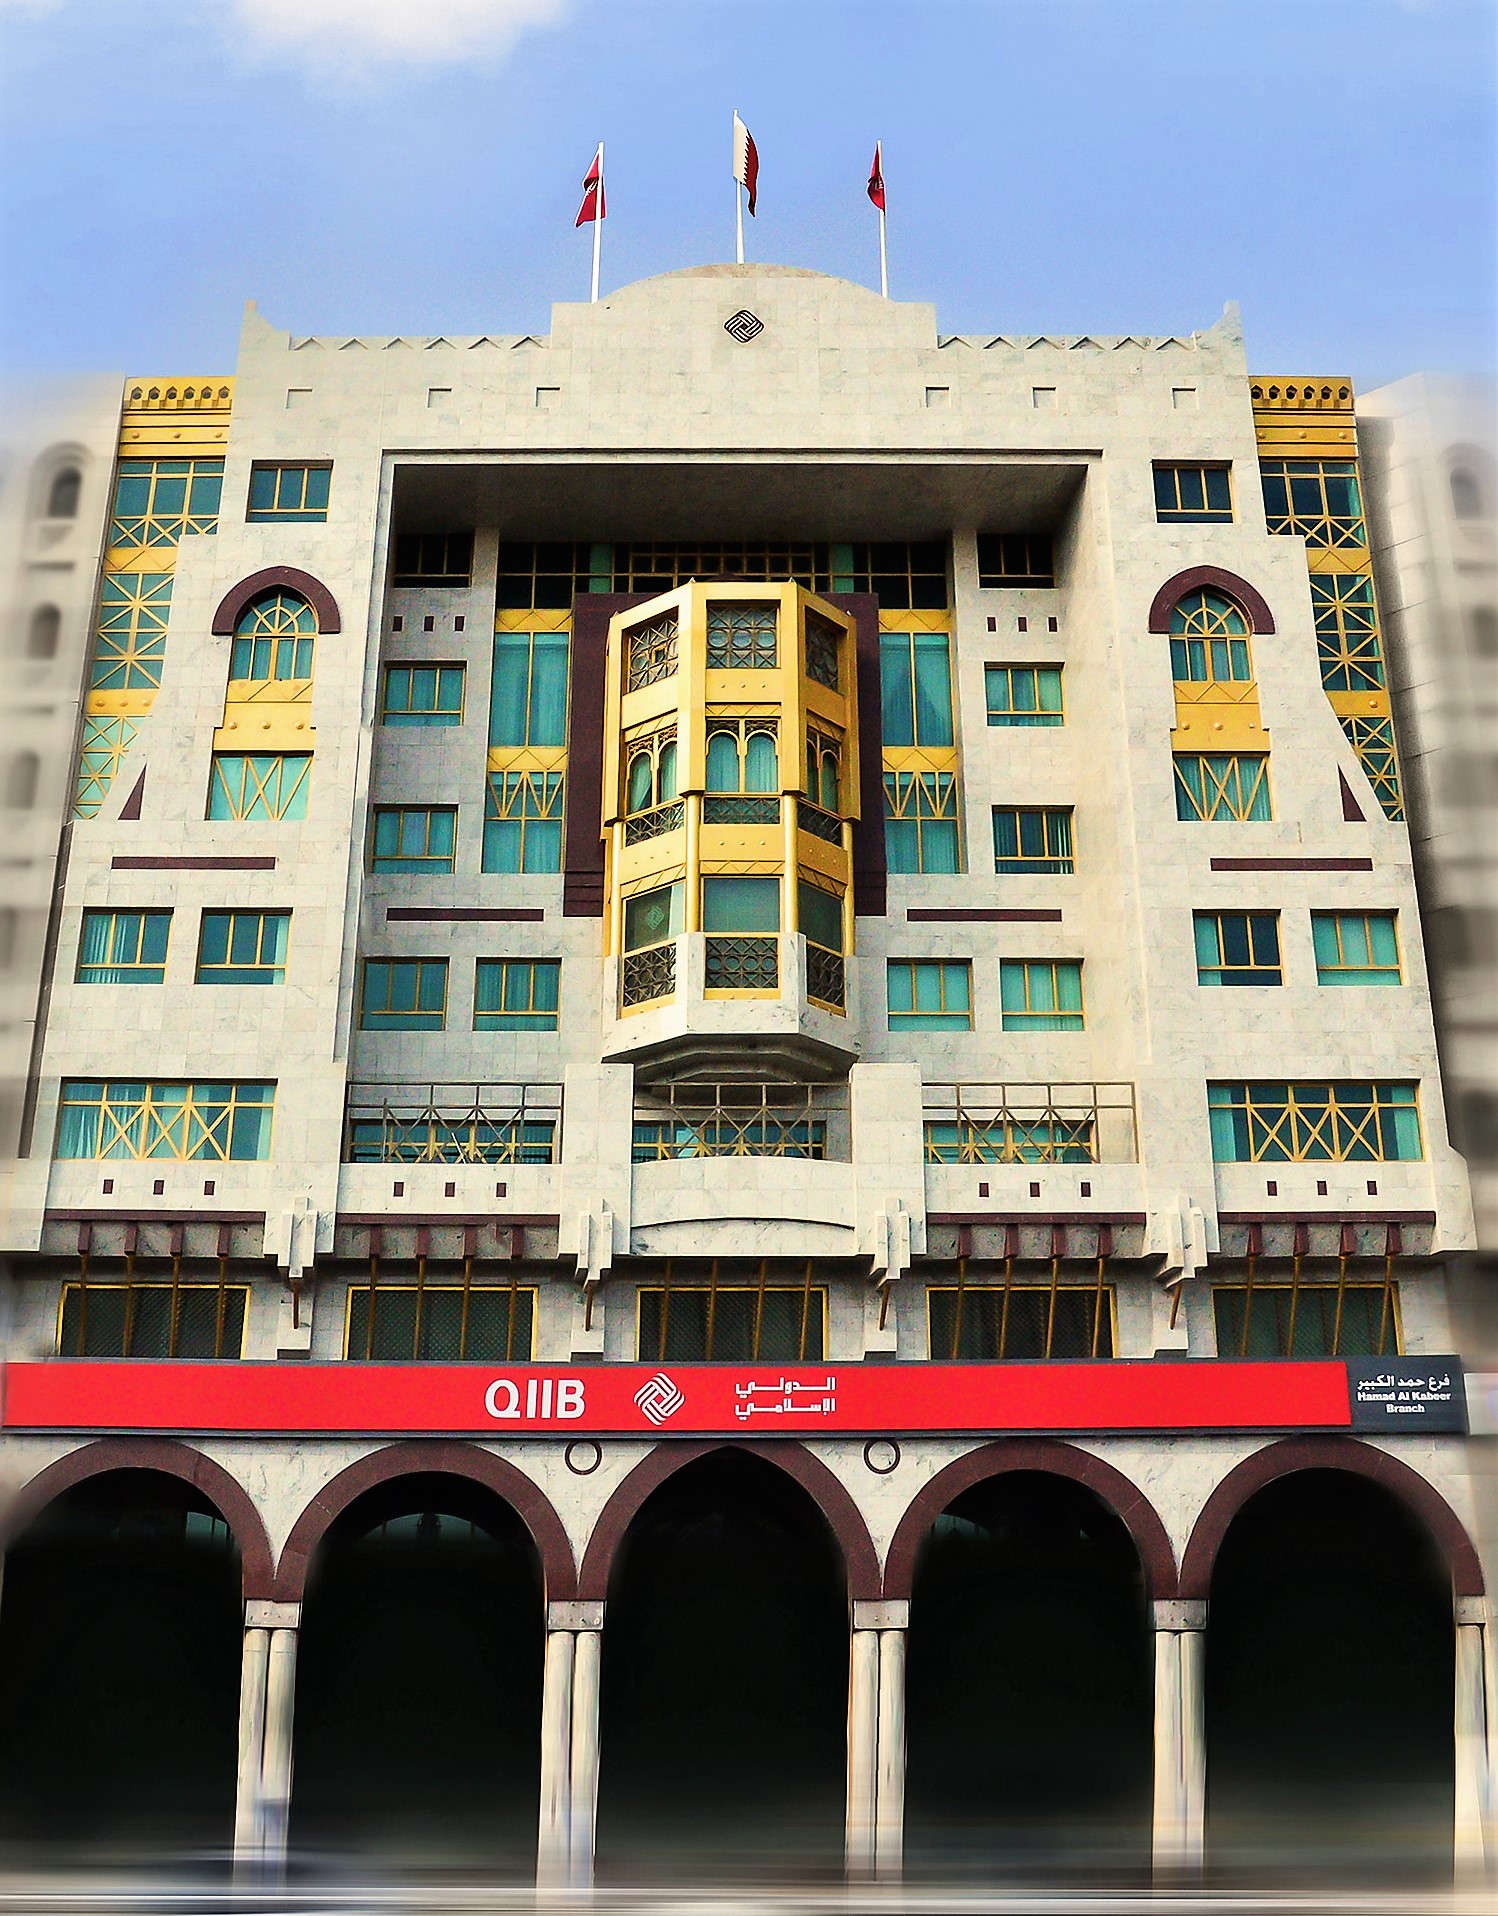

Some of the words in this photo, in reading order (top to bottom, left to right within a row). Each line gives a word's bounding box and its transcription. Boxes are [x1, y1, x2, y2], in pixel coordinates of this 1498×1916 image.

[735, 1376, 836, 1398] الدولي
[1357, 1374, 1395, 1390] الكبير
[1397, 1378, 1425, 1387] حمد
[1428, 1373, 1451, 1391] فرع
[484, 1378, 586, 1419] QIIB
[1357, 1391, 1396, 1402] Hamad
[1397, 1391, 1410, 1401] Al
[1411, 1391, 1452, 1401] Kabeer
[735, 1398, 836, 1420] الإسلامي
[1386, 1403, 1425, 1414] Branch
